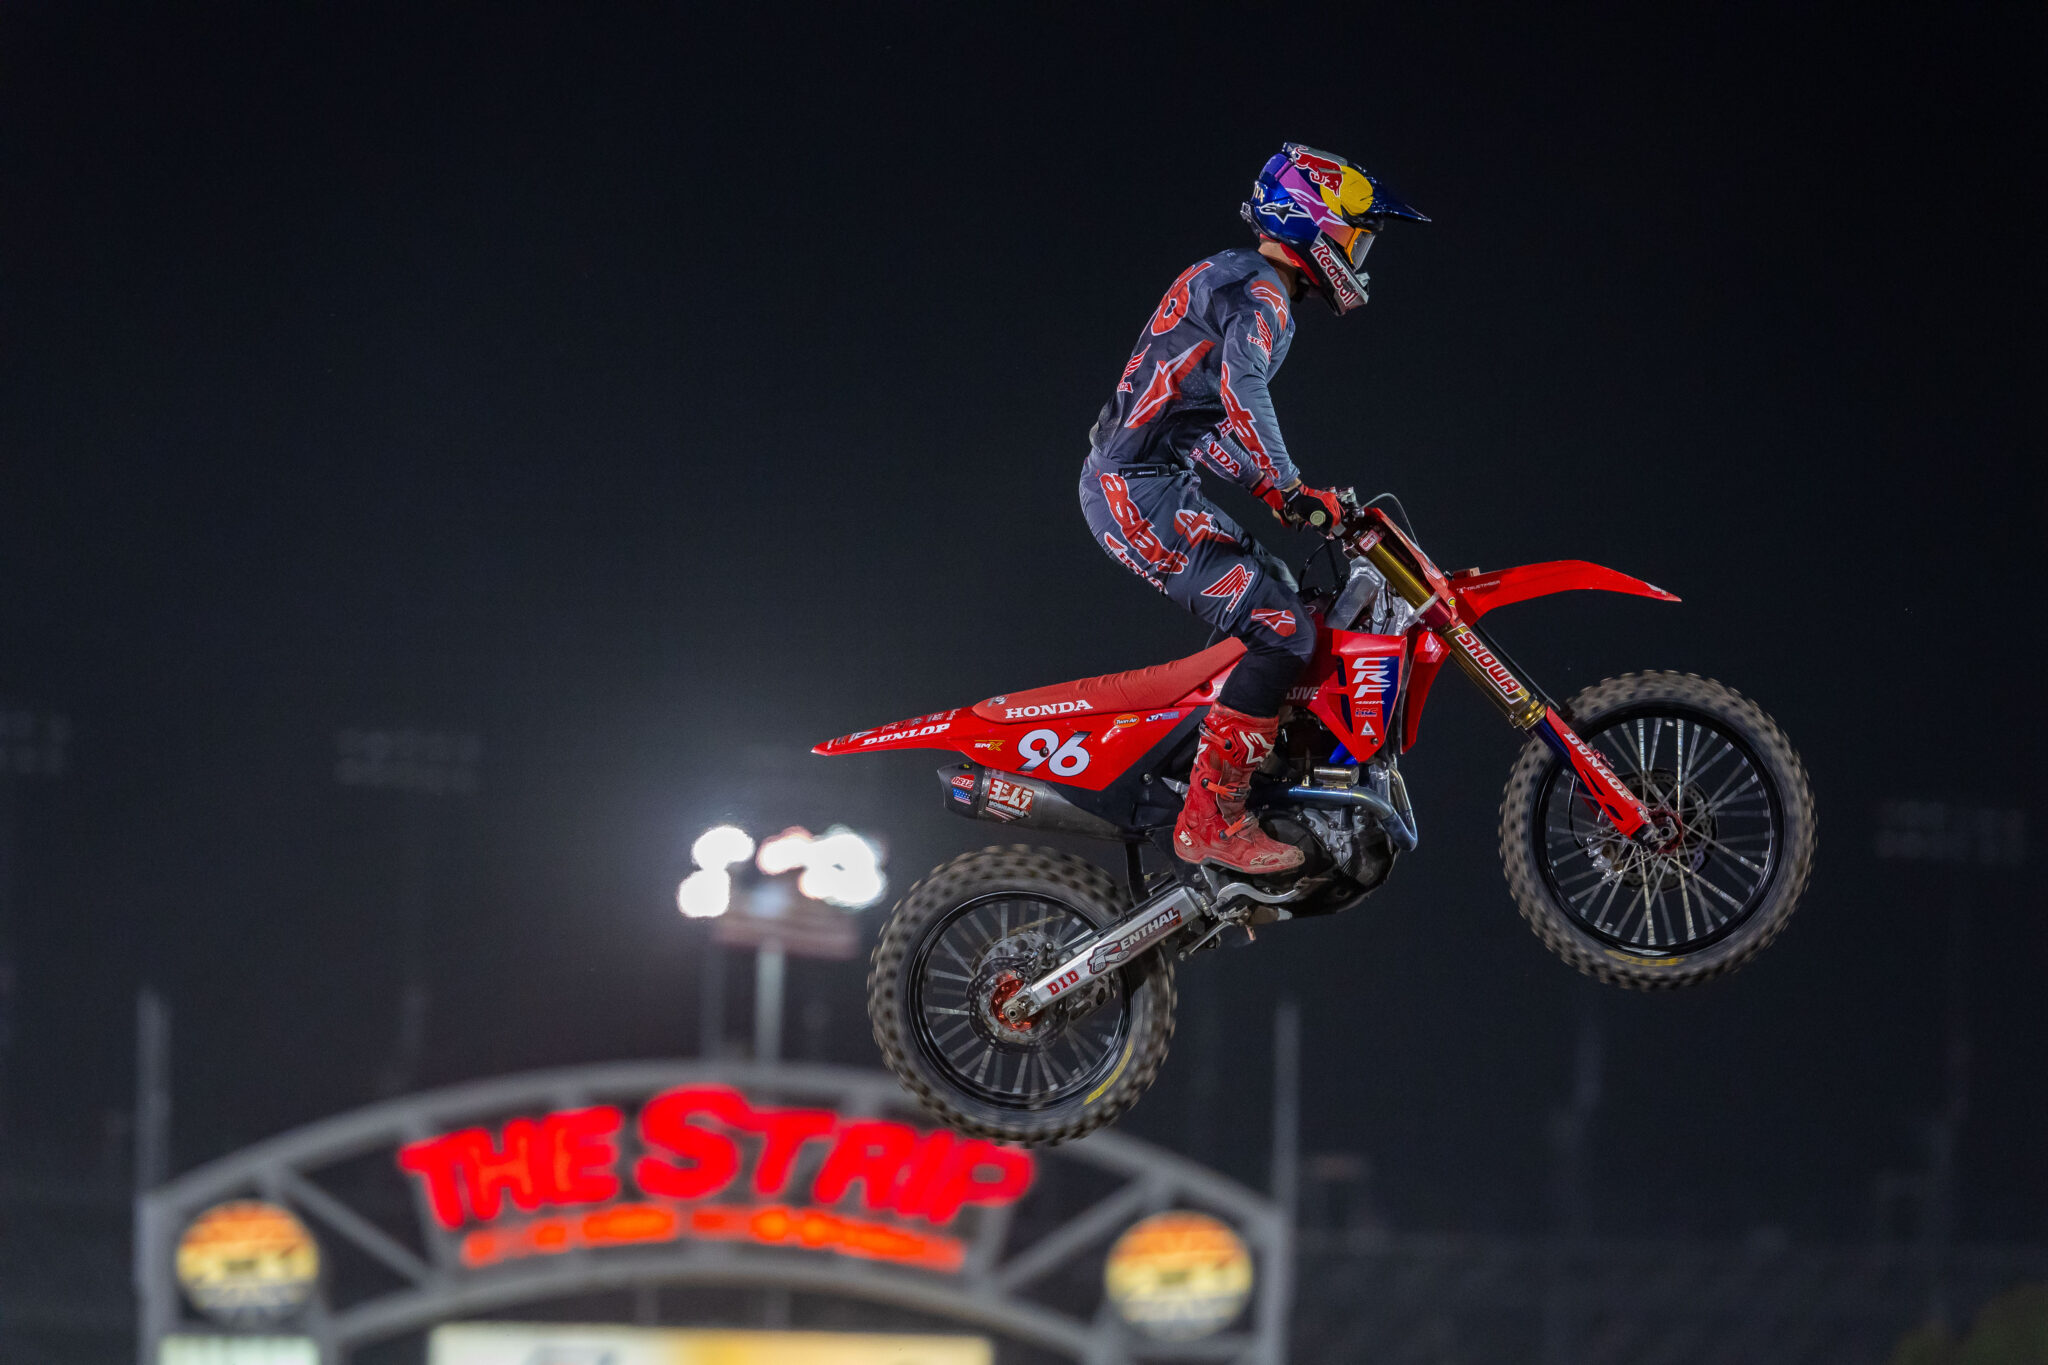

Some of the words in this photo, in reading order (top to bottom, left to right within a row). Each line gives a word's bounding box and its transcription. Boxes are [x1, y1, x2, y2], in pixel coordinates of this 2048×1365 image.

[1352, 657, 1391, 699] CRF
[1455, 631, 1521, 695] SHOWA
[860, 723, 951, 746] DUNLOP
[1005, 699, 1093, 719] HONDA
[1016, 728, 1092, 777] 96
[1564, 732, 1634, 801] DUNLOP
[1088, 909, 1180, 974] RENTHAL
[401, 1106, 624, 1229] THE
[636, 1083, 1034, 1223] STRIP
